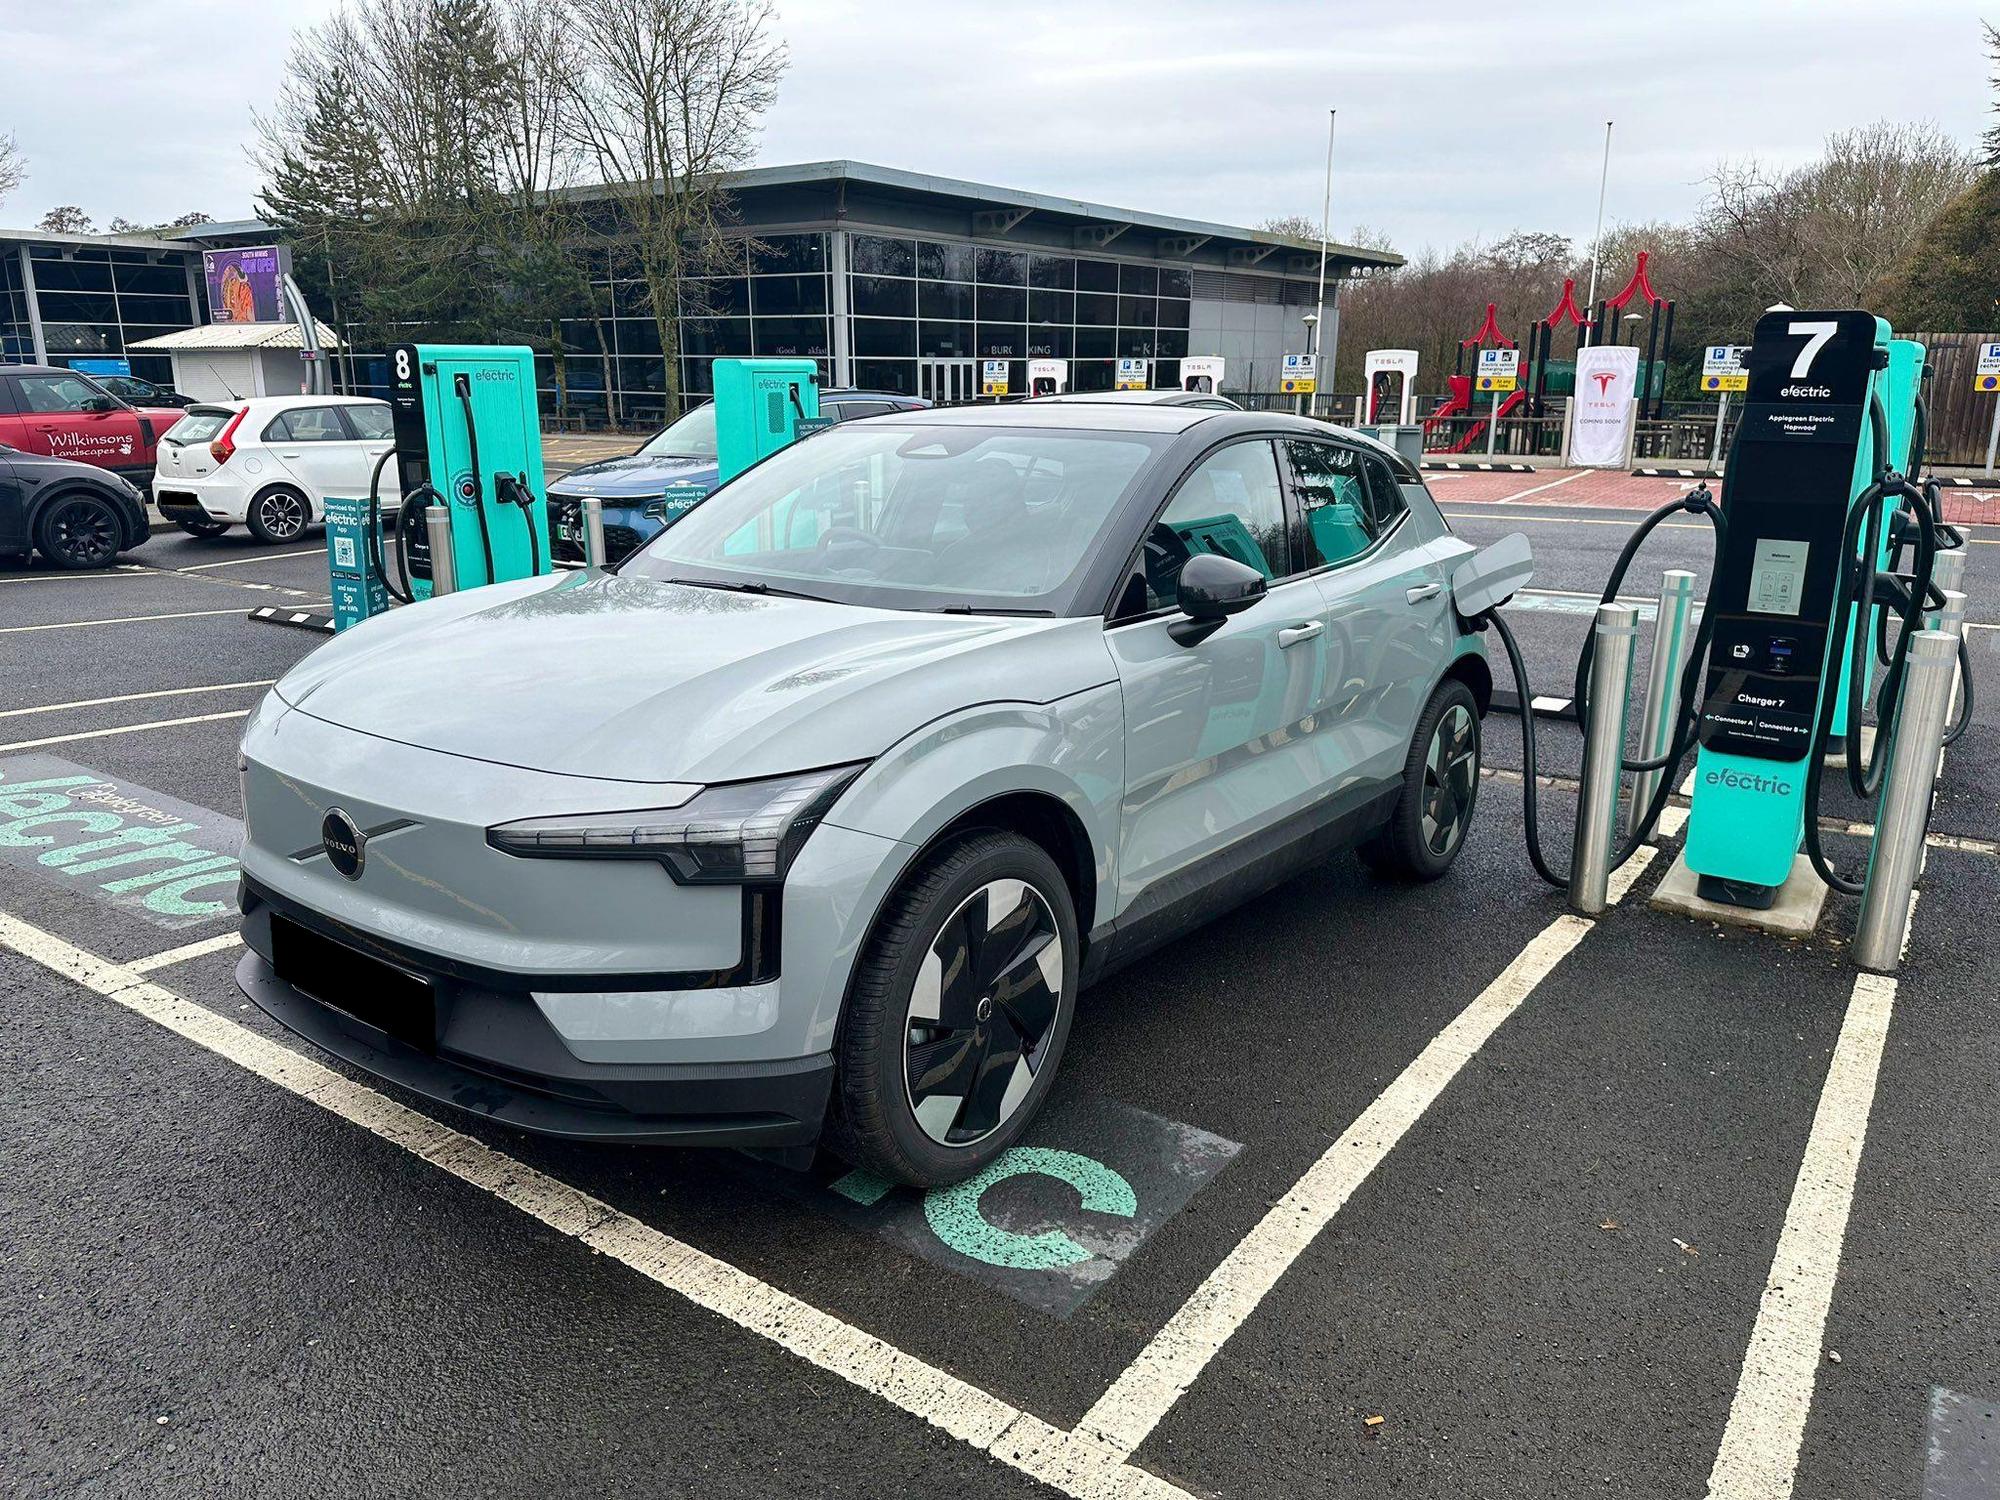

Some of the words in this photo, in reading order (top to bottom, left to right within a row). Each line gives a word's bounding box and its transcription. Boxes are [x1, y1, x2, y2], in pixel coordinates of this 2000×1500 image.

[1788, 321, 1838, 378] 7
[396, 349, 410, 380] 8
[475, 369, 515, 381] electric
[759, 379, 786, 389] electric
[1780, 385, 1830, 397] electric
[1768, 414, 1807, 423] Applegreen
[48, 432, 133, 446] Wilkinsons
[51, 447, 115, 457] Landscapes
[325, 503, 347, 511] Download
[326, 512, 358, 526] electric
[344, 593, 353, 604] 5p
[375, 592, 381, 603] 5p
[1738, 694, 1778, 707] Charger
[1714, 715, 1747, 725] Connector
[1759, 722, 1793, 732] Connector
[1706, 768, 1791, 796] electric
[0, 771, 241, 916] lectric
[324, 837, 356, 854] VOLVO
